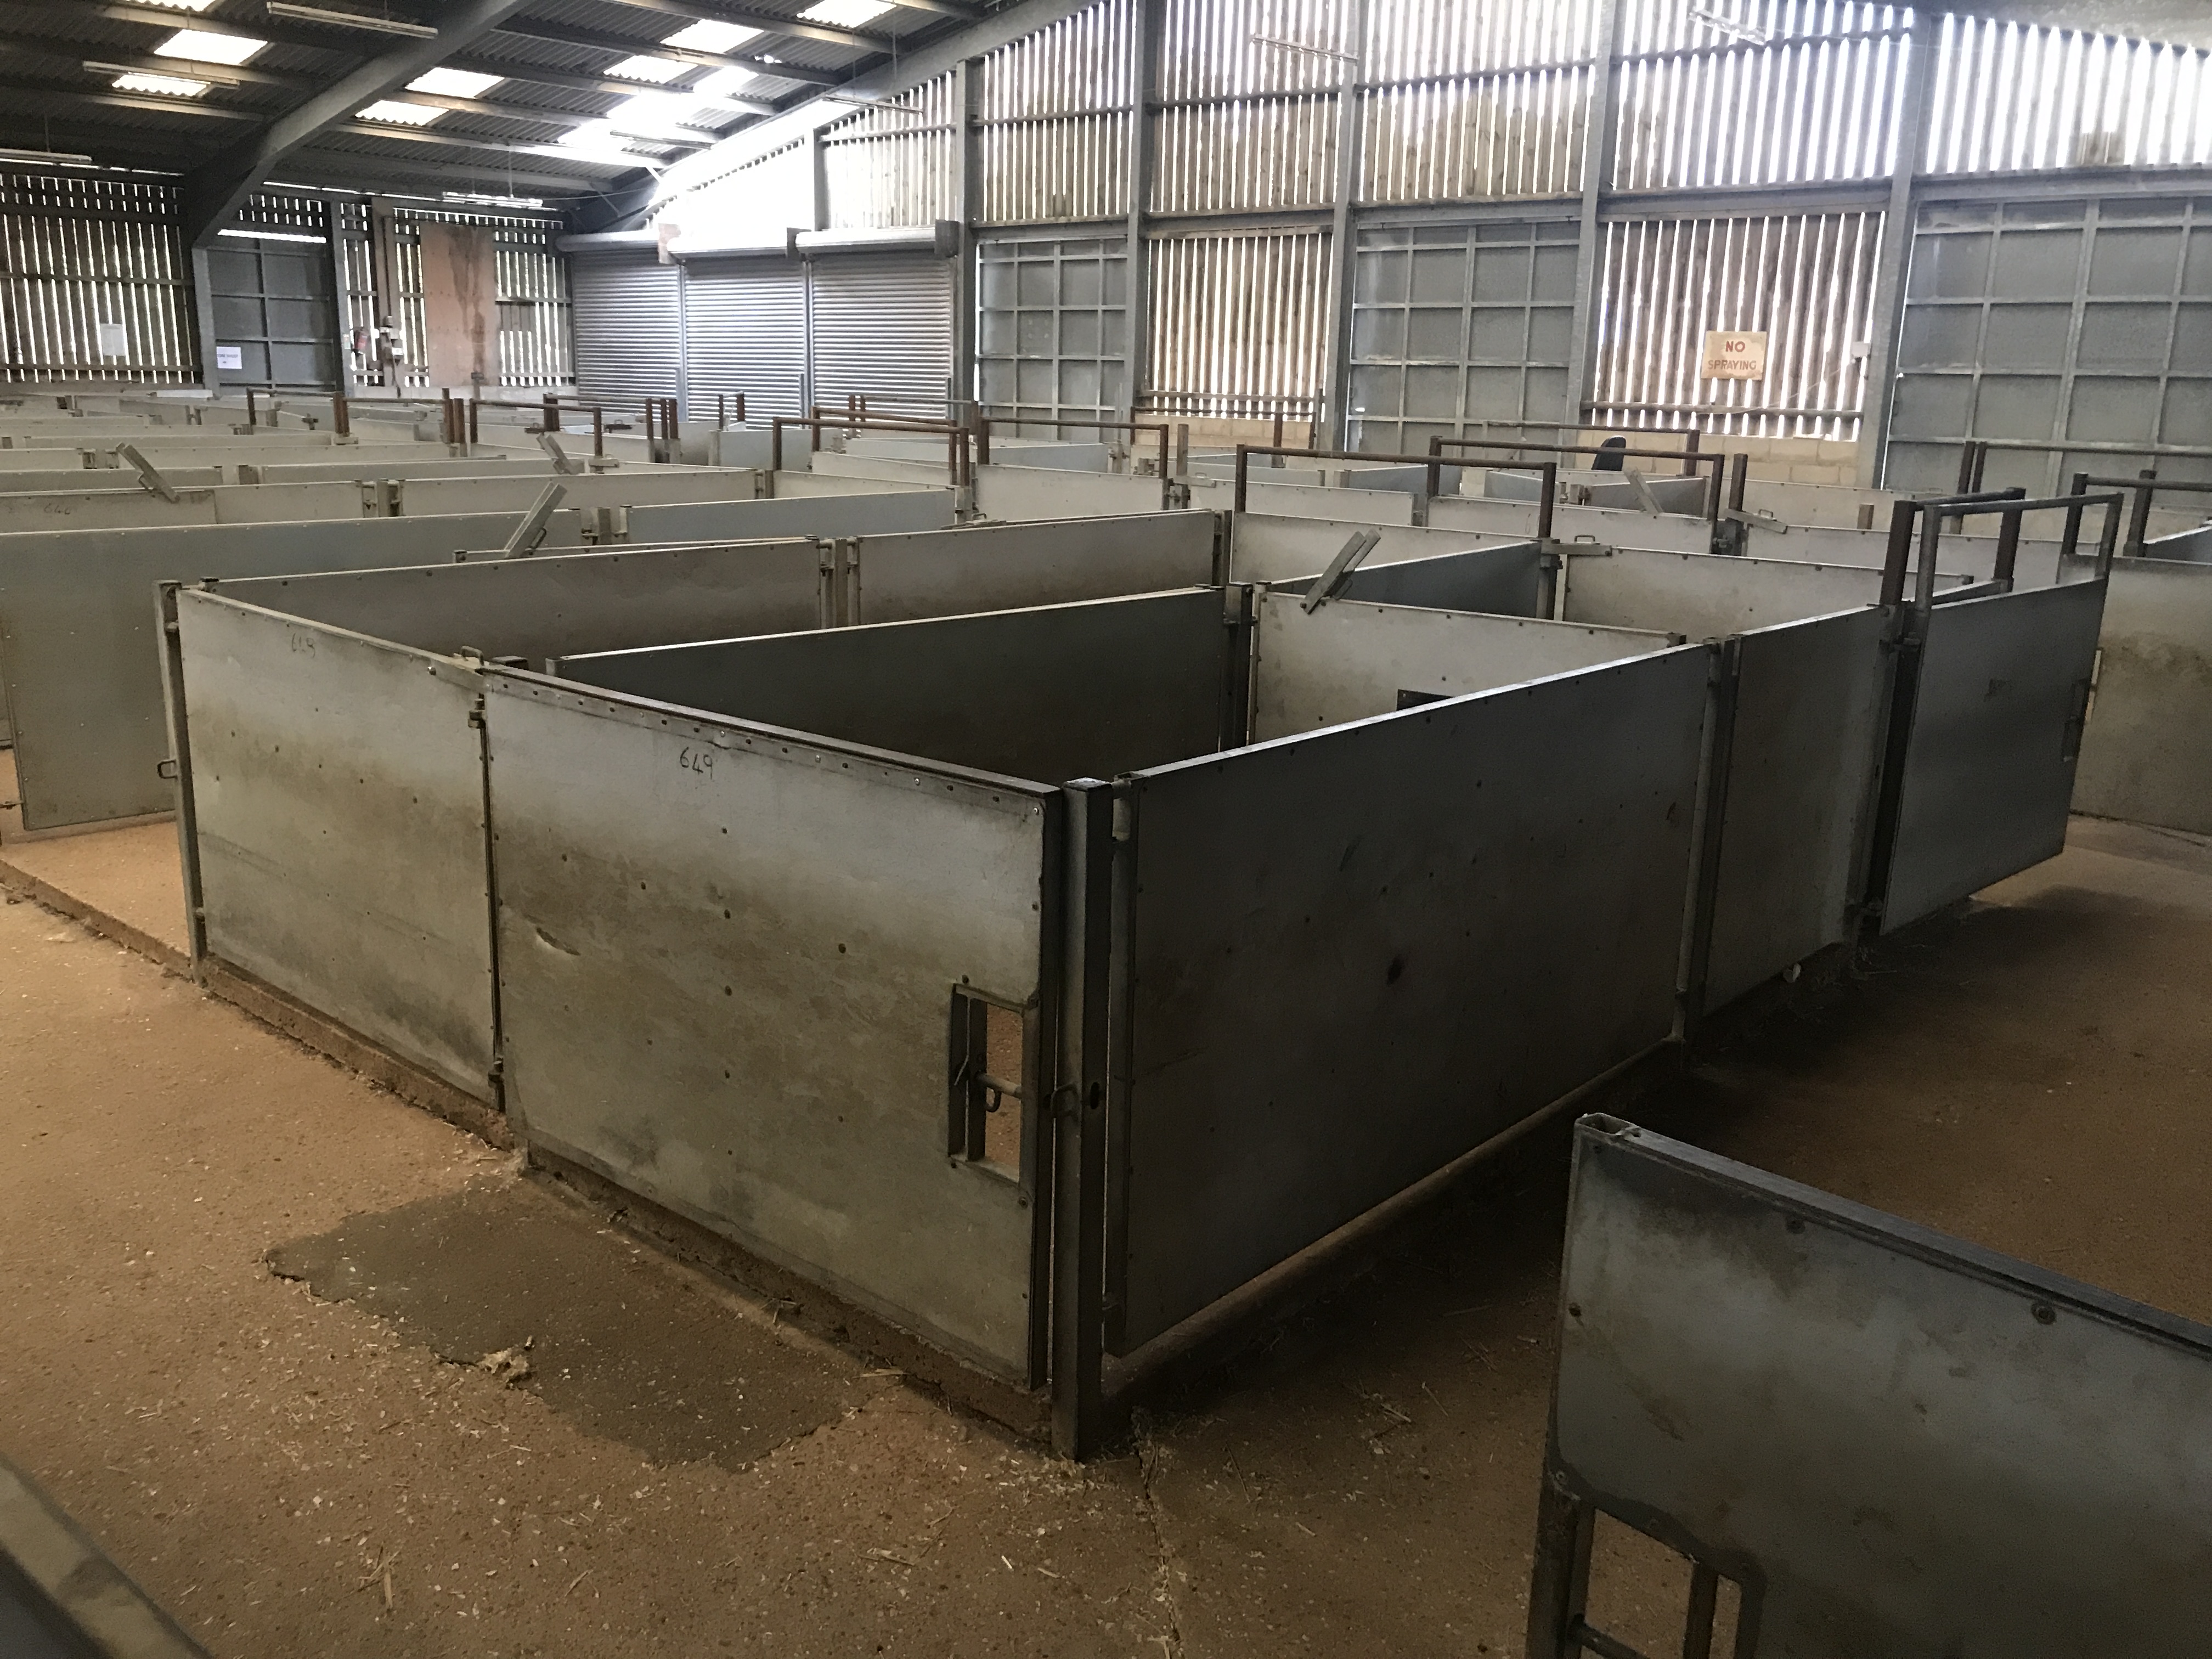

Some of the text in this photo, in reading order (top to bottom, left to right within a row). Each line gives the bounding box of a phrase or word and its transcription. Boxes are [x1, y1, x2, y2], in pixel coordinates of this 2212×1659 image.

[1725, 340, 1746, 352] NO
[1708, 359, 1757, 370] SPRAYING
[680, 747, 713, 780] 649
